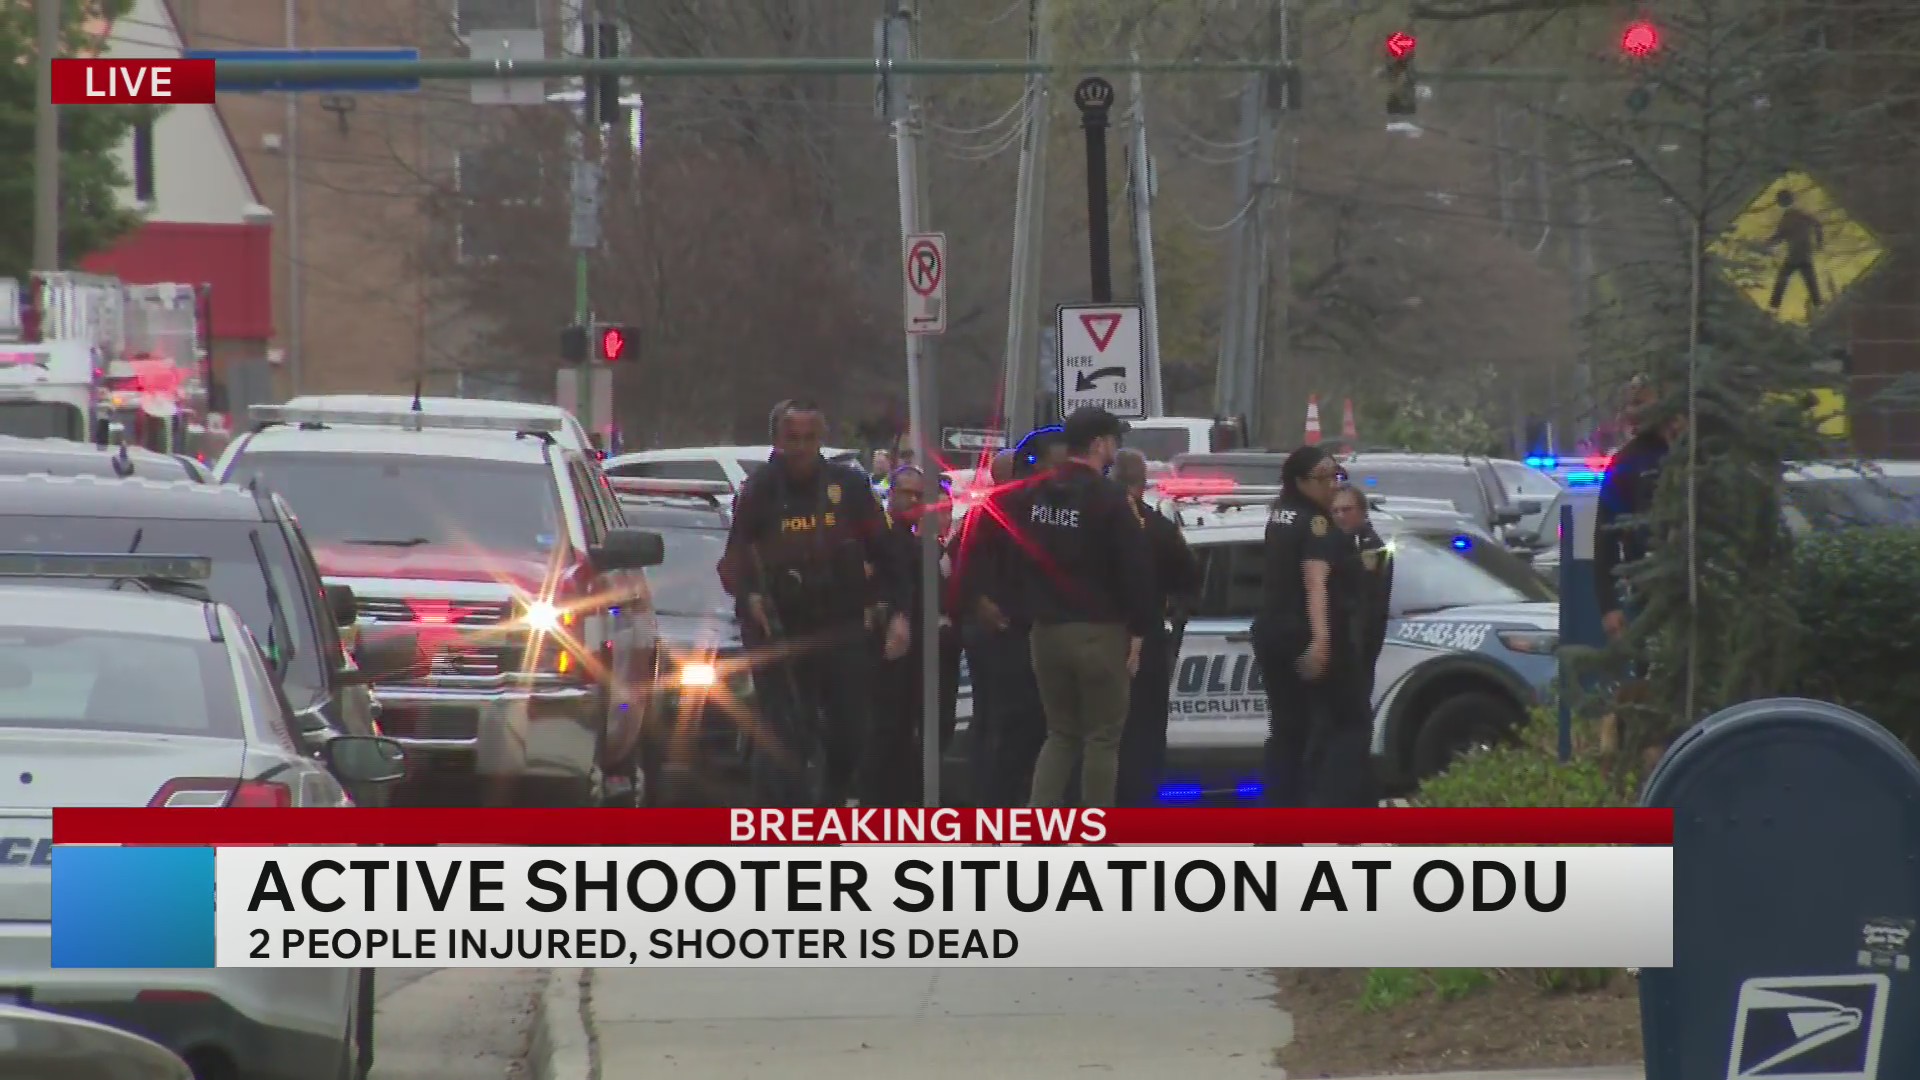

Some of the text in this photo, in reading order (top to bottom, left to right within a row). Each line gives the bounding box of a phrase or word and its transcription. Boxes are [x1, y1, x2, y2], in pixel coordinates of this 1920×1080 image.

[1066, 356, 1094, 367] HERE
[1114, 382, 1127, 393] TO
[781, 512, 836, 532] POLIE
[1030, 504, 1080, 528] POLICE
[1169, 700, 1270, 713] RECRUITE
